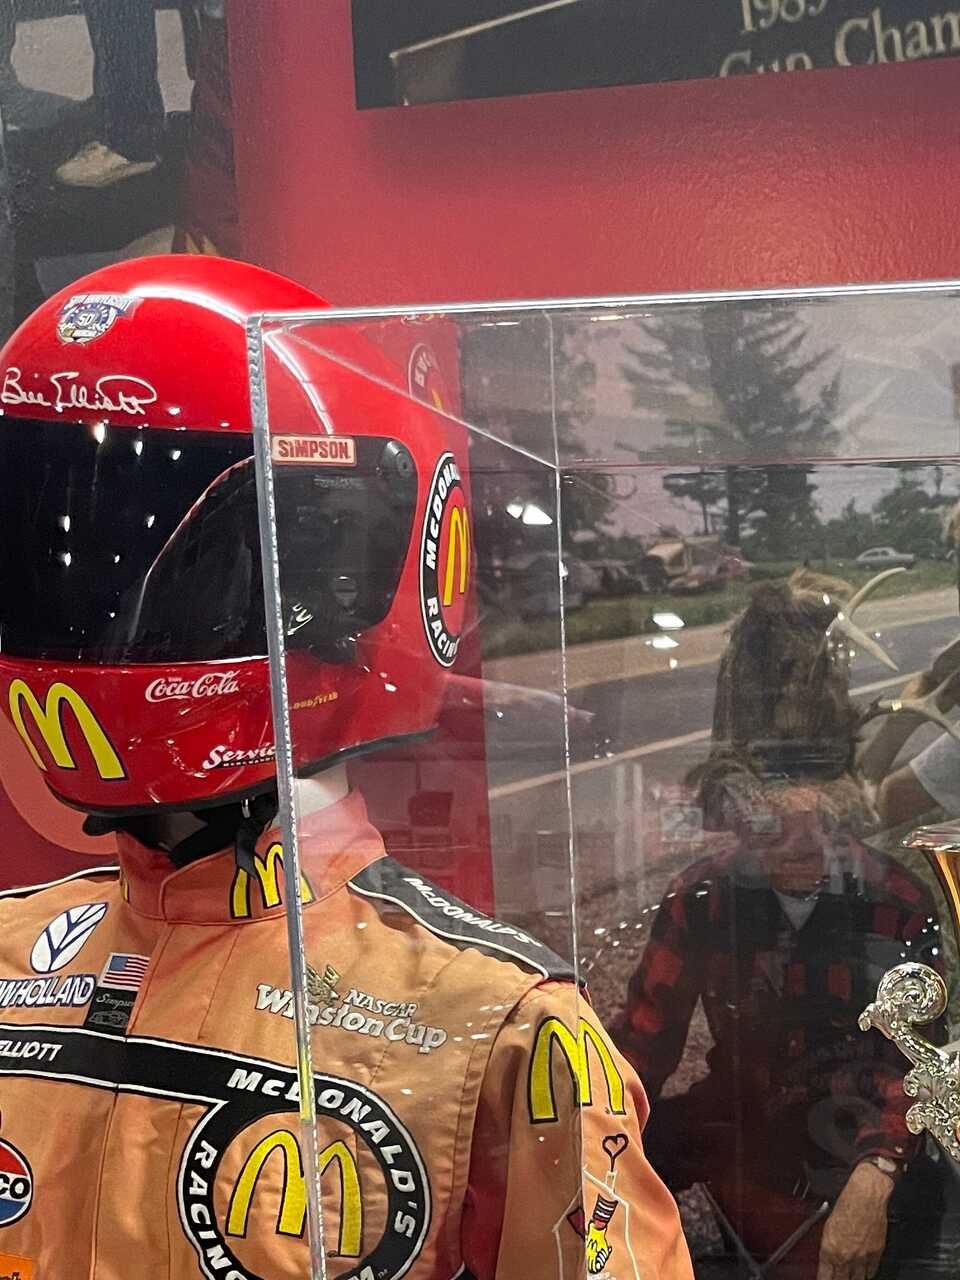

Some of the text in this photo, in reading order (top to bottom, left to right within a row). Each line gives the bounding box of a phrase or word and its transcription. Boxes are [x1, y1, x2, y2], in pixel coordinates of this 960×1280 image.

[278, 440, 349, 459] SIMPSON
[145, 670, 240, 702] Coca-Cola
[343, 988, 417, 1017] NASCAR
[384, 1016, 448, 1054] Cup
